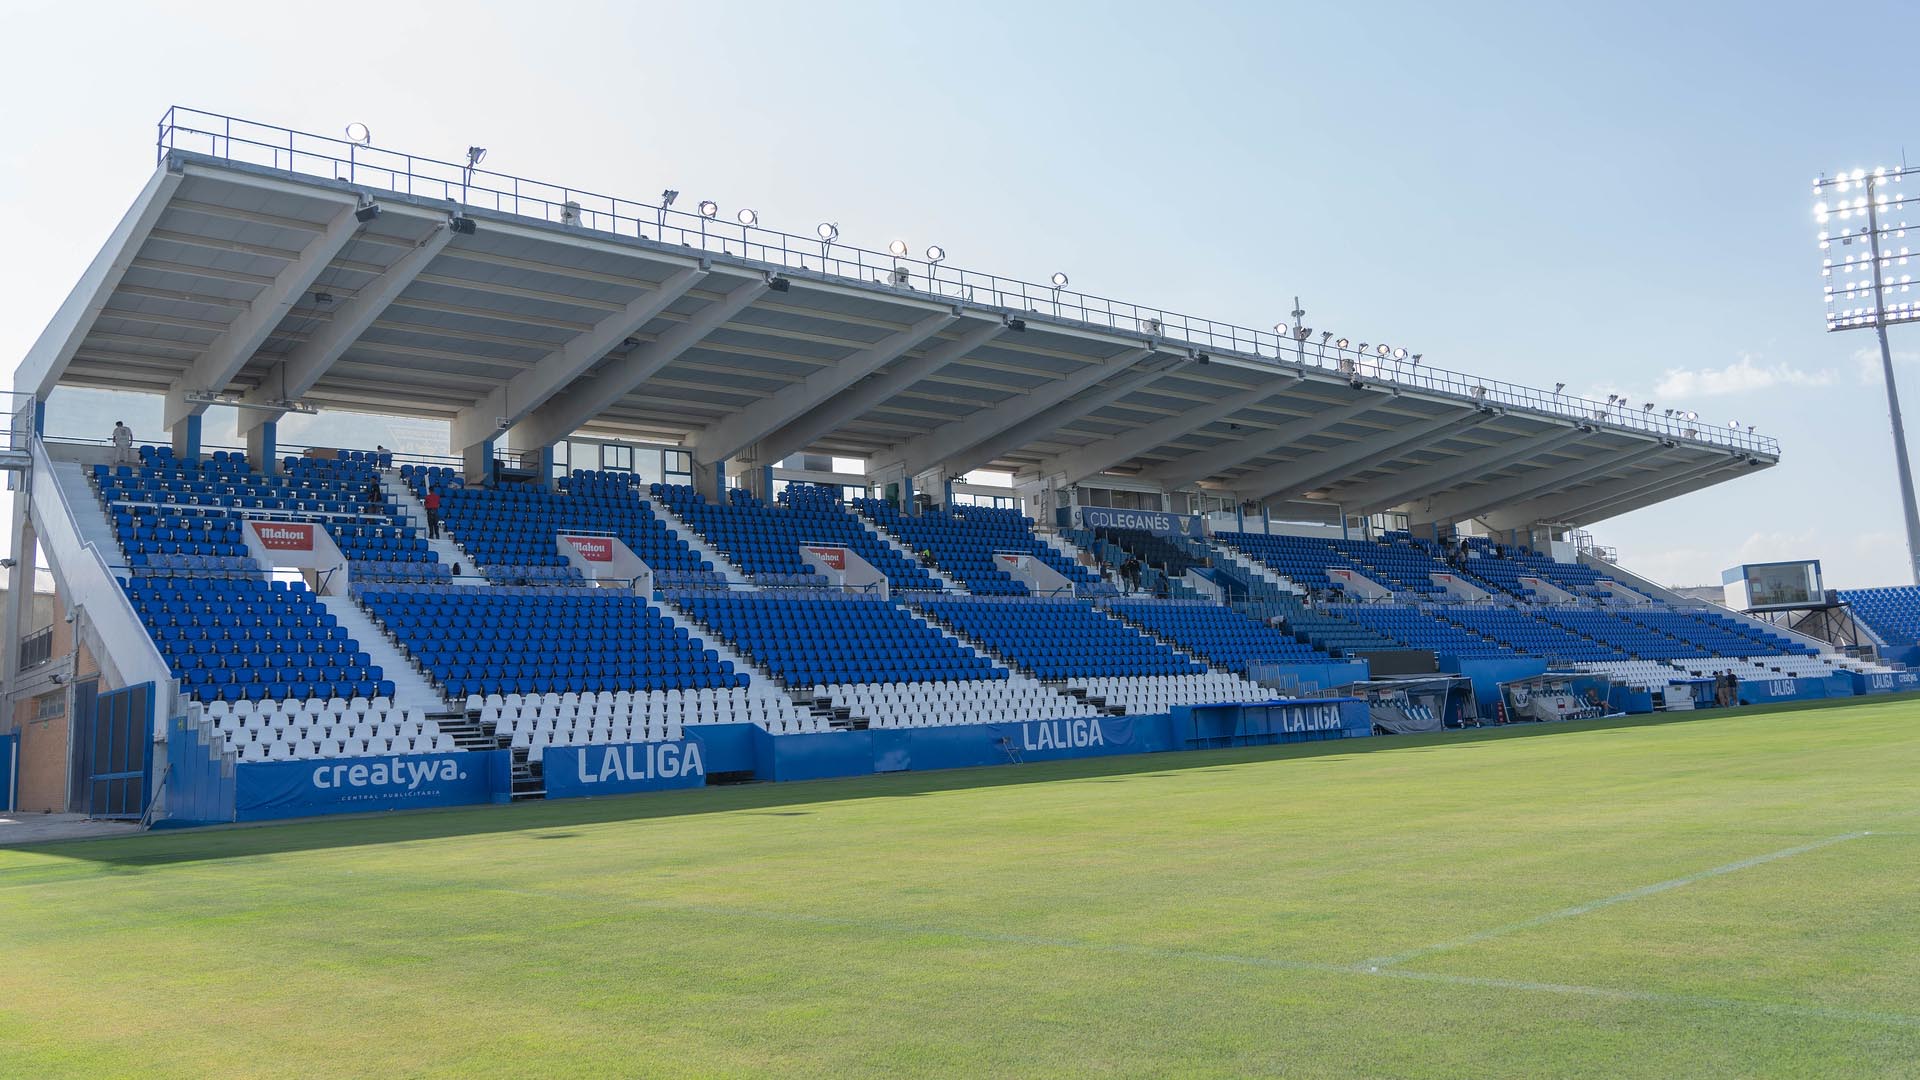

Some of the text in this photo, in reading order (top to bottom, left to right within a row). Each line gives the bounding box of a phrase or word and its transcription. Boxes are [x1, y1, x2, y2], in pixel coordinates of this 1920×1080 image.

[261, 528, 304, 540] Mahou
[1769, 680, 1796, 696] LALIGA
[1872, 674, 1894, 688] LALIGA
[1023, 720, 1104, 751] LALIGA
[578, 743, 704, 783] LALIGA
[383, 790, 440, 798] PUBLICITARIA
